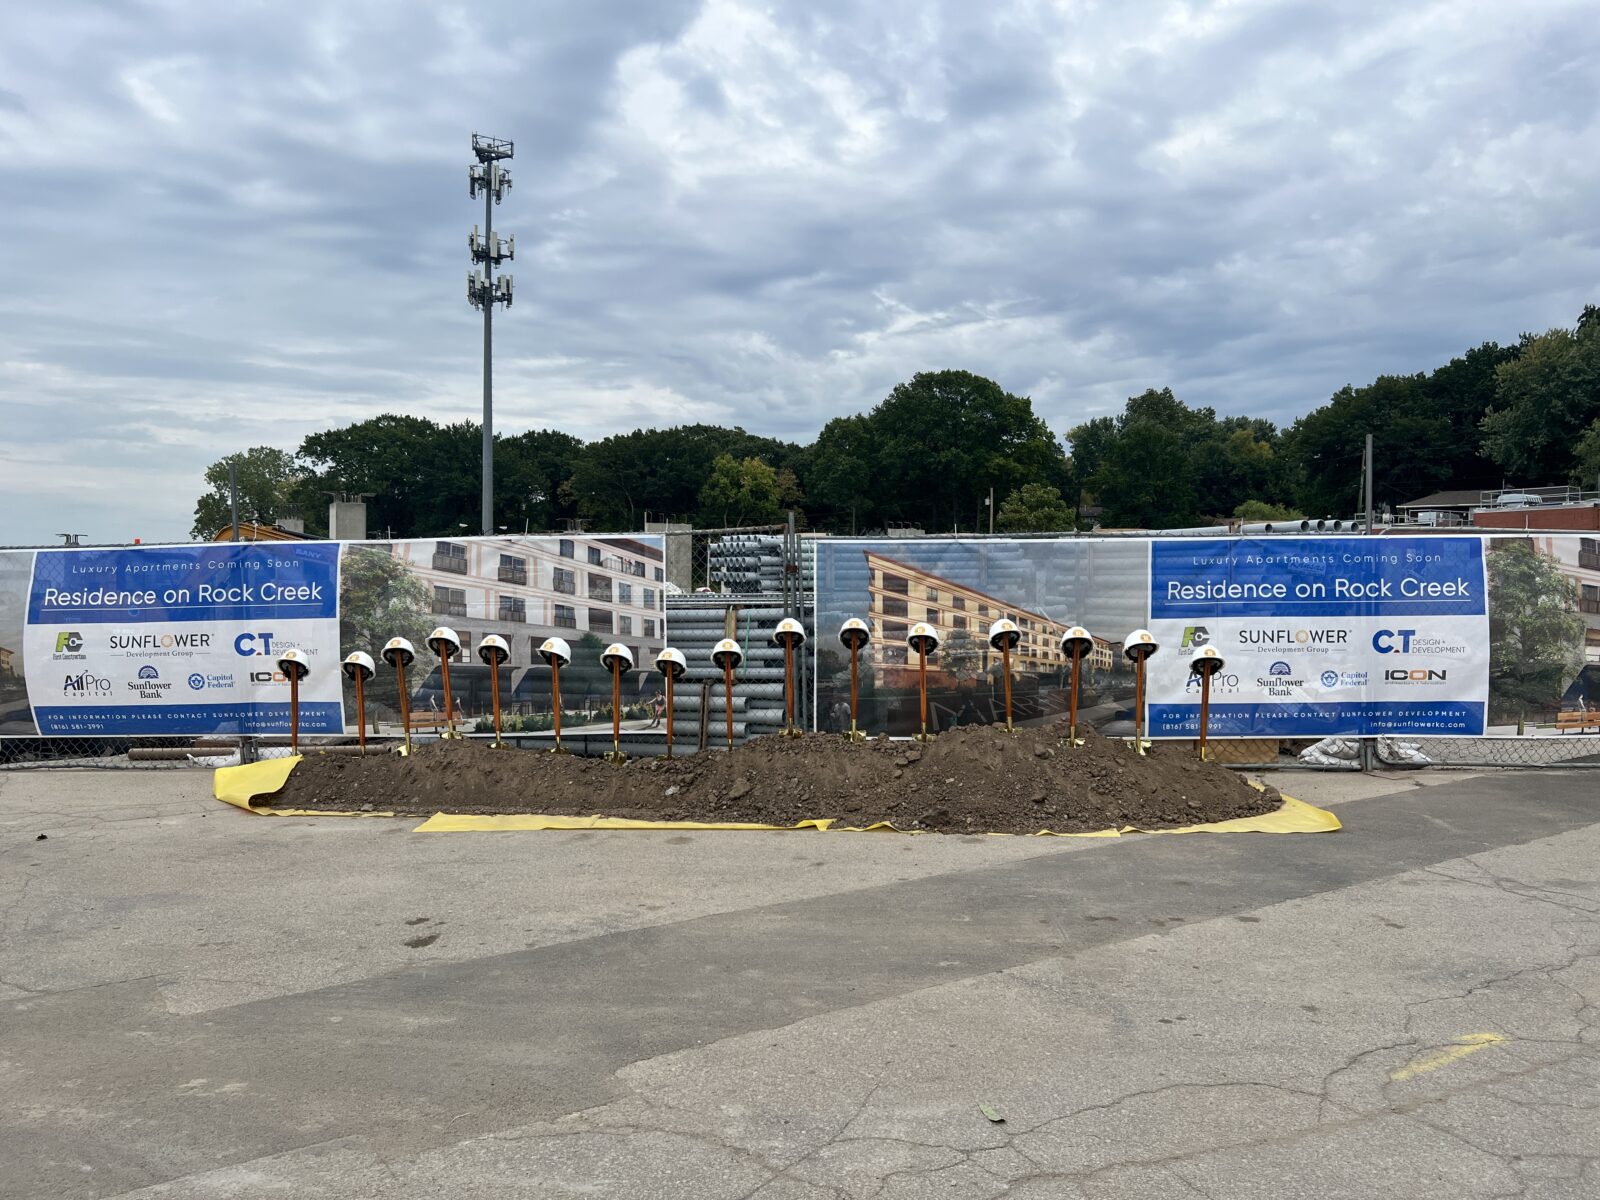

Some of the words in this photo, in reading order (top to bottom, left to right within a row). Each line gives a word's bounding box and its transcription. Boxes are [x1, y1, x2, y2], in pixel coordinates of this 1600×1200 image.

[1193, 556, 1238, 566] Luxury
[1246, 555, 1334, 565] Apartments
[1343, 554, 1398, 565] Coming
[1406, 554, 1441, 562] Soon
[73, 565, 118, 575] Luxury
[125, 562, 200, 574] Apartments
[208, 560, 260, 570] Coming
[267, 559, 299, 568] Soon
[1167, 580, 1287, 600] Residence
[1295, 583, 1326, 598] on
[1335, 578, 1393, 597] Rock
[1400, 577, 1470, 597] Creek
[44, 588, 156, 606] Residence
[164, 589, 190, 604] on
[199, 583, 254, 602] Rock
[261, 582, 323, 601] Creek
[110, 633, 210, 649] SUNFLOWER
[1239, 629, 1347, 644] SUNFLOWER
[1306, 646, 1329, 654] Group
[1412, 646, 1466, 654] DEVELOPMENT
[207, 673, 233, 682] Capitol
[250, 671, 303, 683] ICO
[1341, 671, 1368, 680] Capitol
[1385, 670, 1447, 681] ICON
[128, 681, 172, 690] Sunflower
[207, 681, 234, 689] Federal
[1256, 678, 1304, 687] Sunflower
[140, 690, 162, 699] Bank
[1268, 687, 1293, 696] Bank
